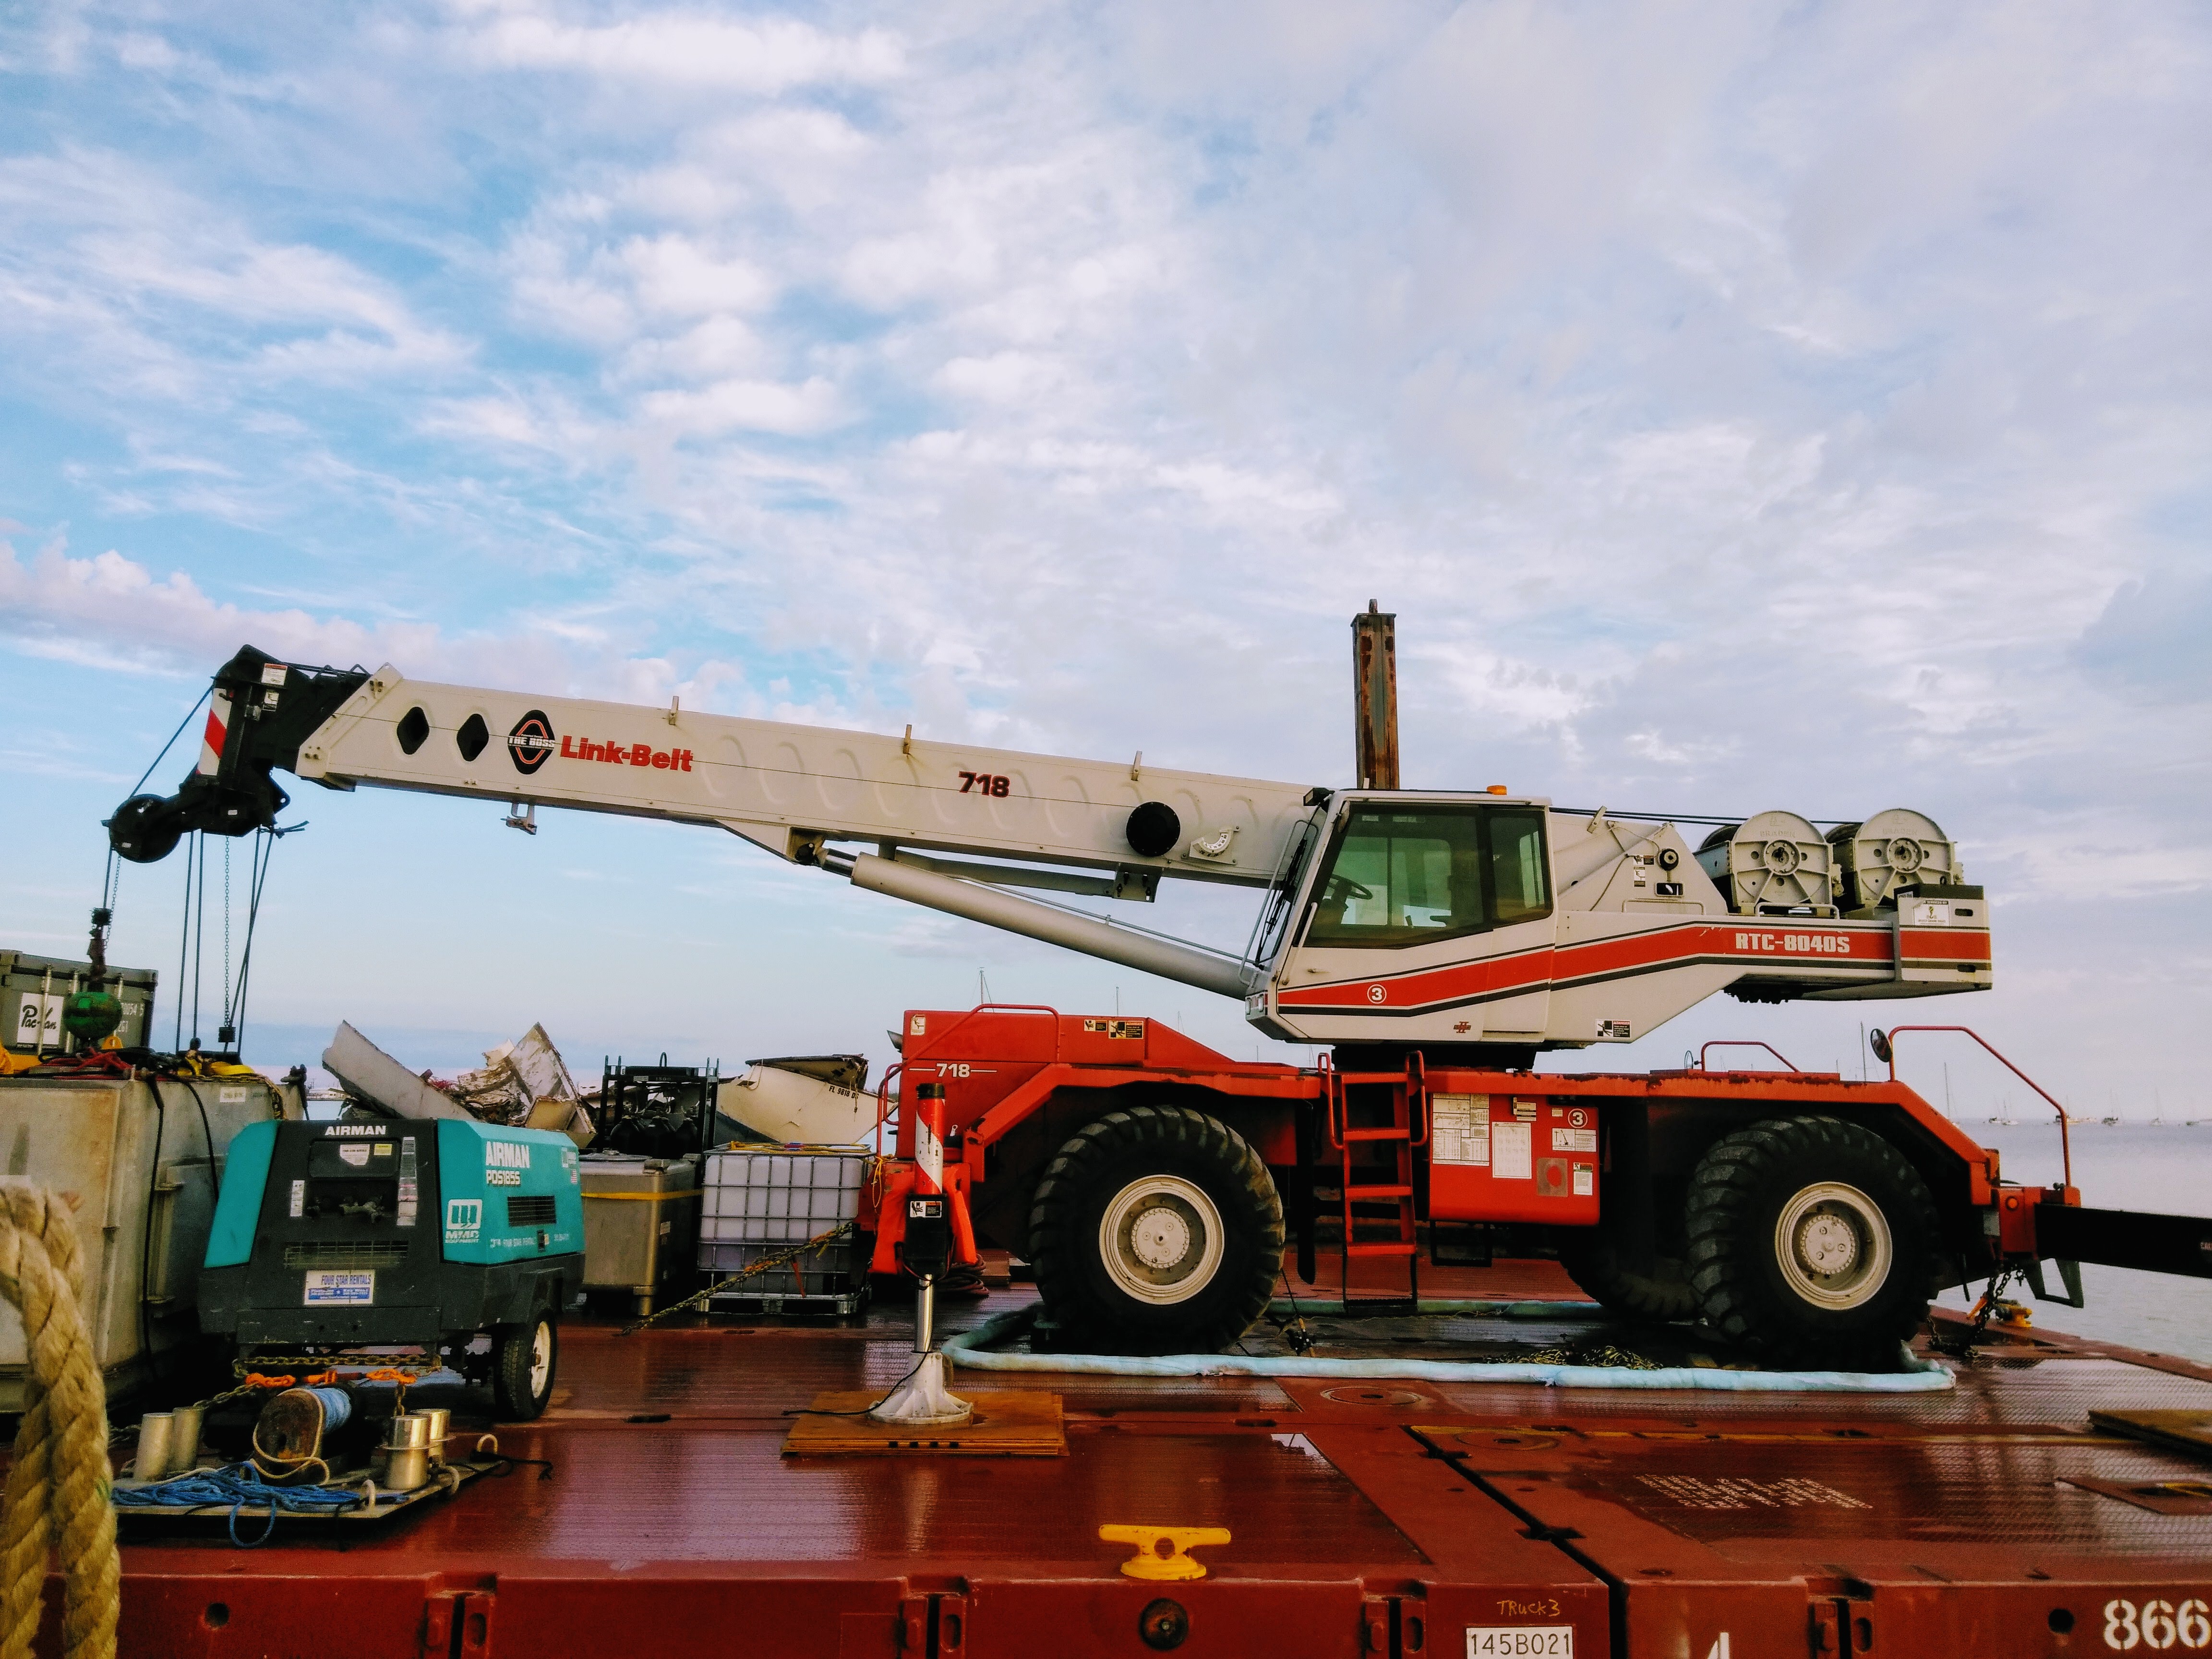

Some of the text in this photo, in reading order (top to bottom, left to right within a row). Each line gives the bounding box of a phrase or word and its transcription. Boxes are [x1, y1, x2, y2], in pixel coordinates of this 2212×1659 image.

[508, 735, 527, 745] THE
[529, 737, 555, 748] BOSS
[560, 735, 693, 772] Link-Belt
[959, 771, 1010, 798] 718
[1735, 933, 1850, 953] RTC-8040S
[1371, 987, 1382, 1000] 3
[937, 1063, 970, 1078] 718
[837, 1088, 851, 1097] 9818
[1573, 1112, 1584, 1126] 3
[325, 1125, 386, 1136] AIRMAN
[486, 1141, 530, 1168] AIRMAN
[486, 1169, 520, 1185] PDS185S
[321, 1274, 371, 1285] FOUR STAR RENTALS
[1549, 1599, 1560, 1617] 3
[2104, 1599, 2212, 1650] 866
[1471, 1633, 1570, 1655] 145B021
